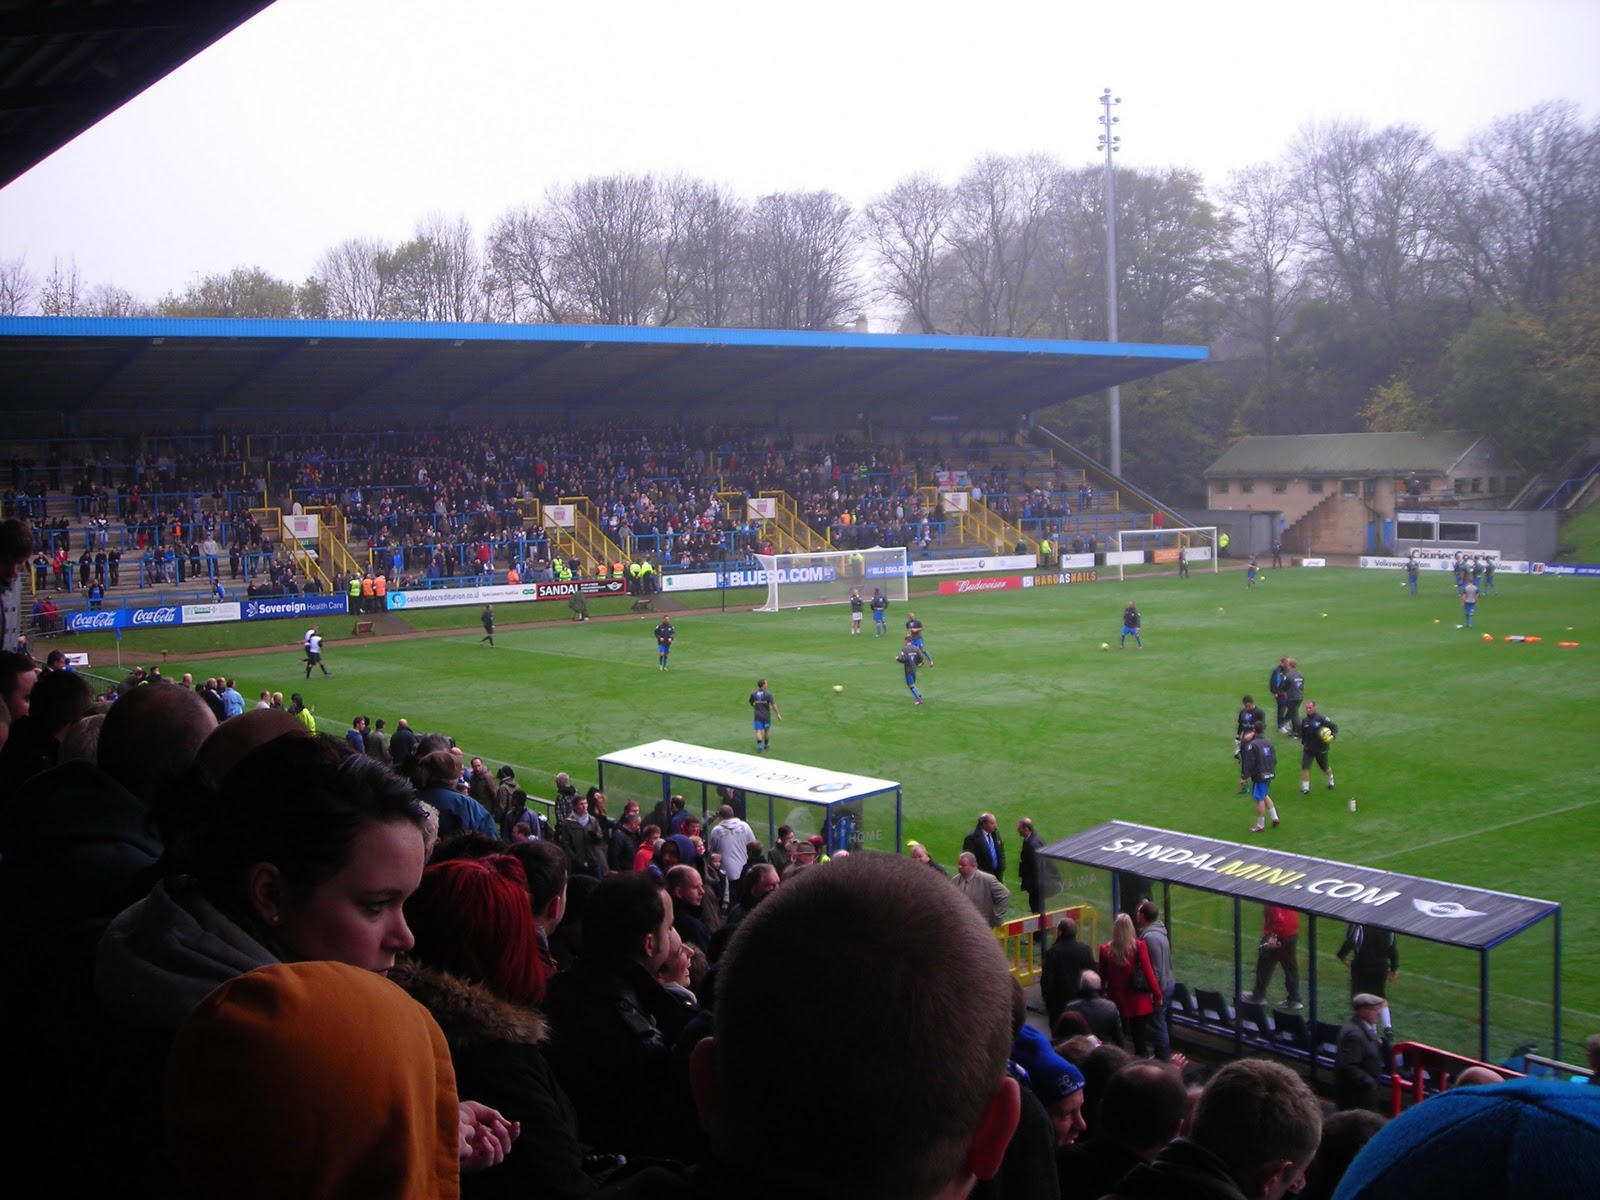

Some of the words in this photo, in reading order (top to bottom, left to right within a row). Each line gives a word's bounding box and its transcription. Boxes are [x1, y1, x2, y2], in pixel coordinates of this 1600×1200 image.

[1412, 549, 1454, 560] Courier
[1375, 559, 1408, 569] Volkswag
[730, 567, 823, 587] BLUESQ.COM
[956, 579, 1007, 593] Budweiser
[407, 591, 479, 603] calderdalecreditunion.co.u
[259, 601, 306, 614] Sovereign
[307, 603, 328, 611] Health
[329, 601, 344, 610] Care
[848, 829, 883, 844] HOME
[1101, 838, 1401, 908] SANDALMINI.COM
